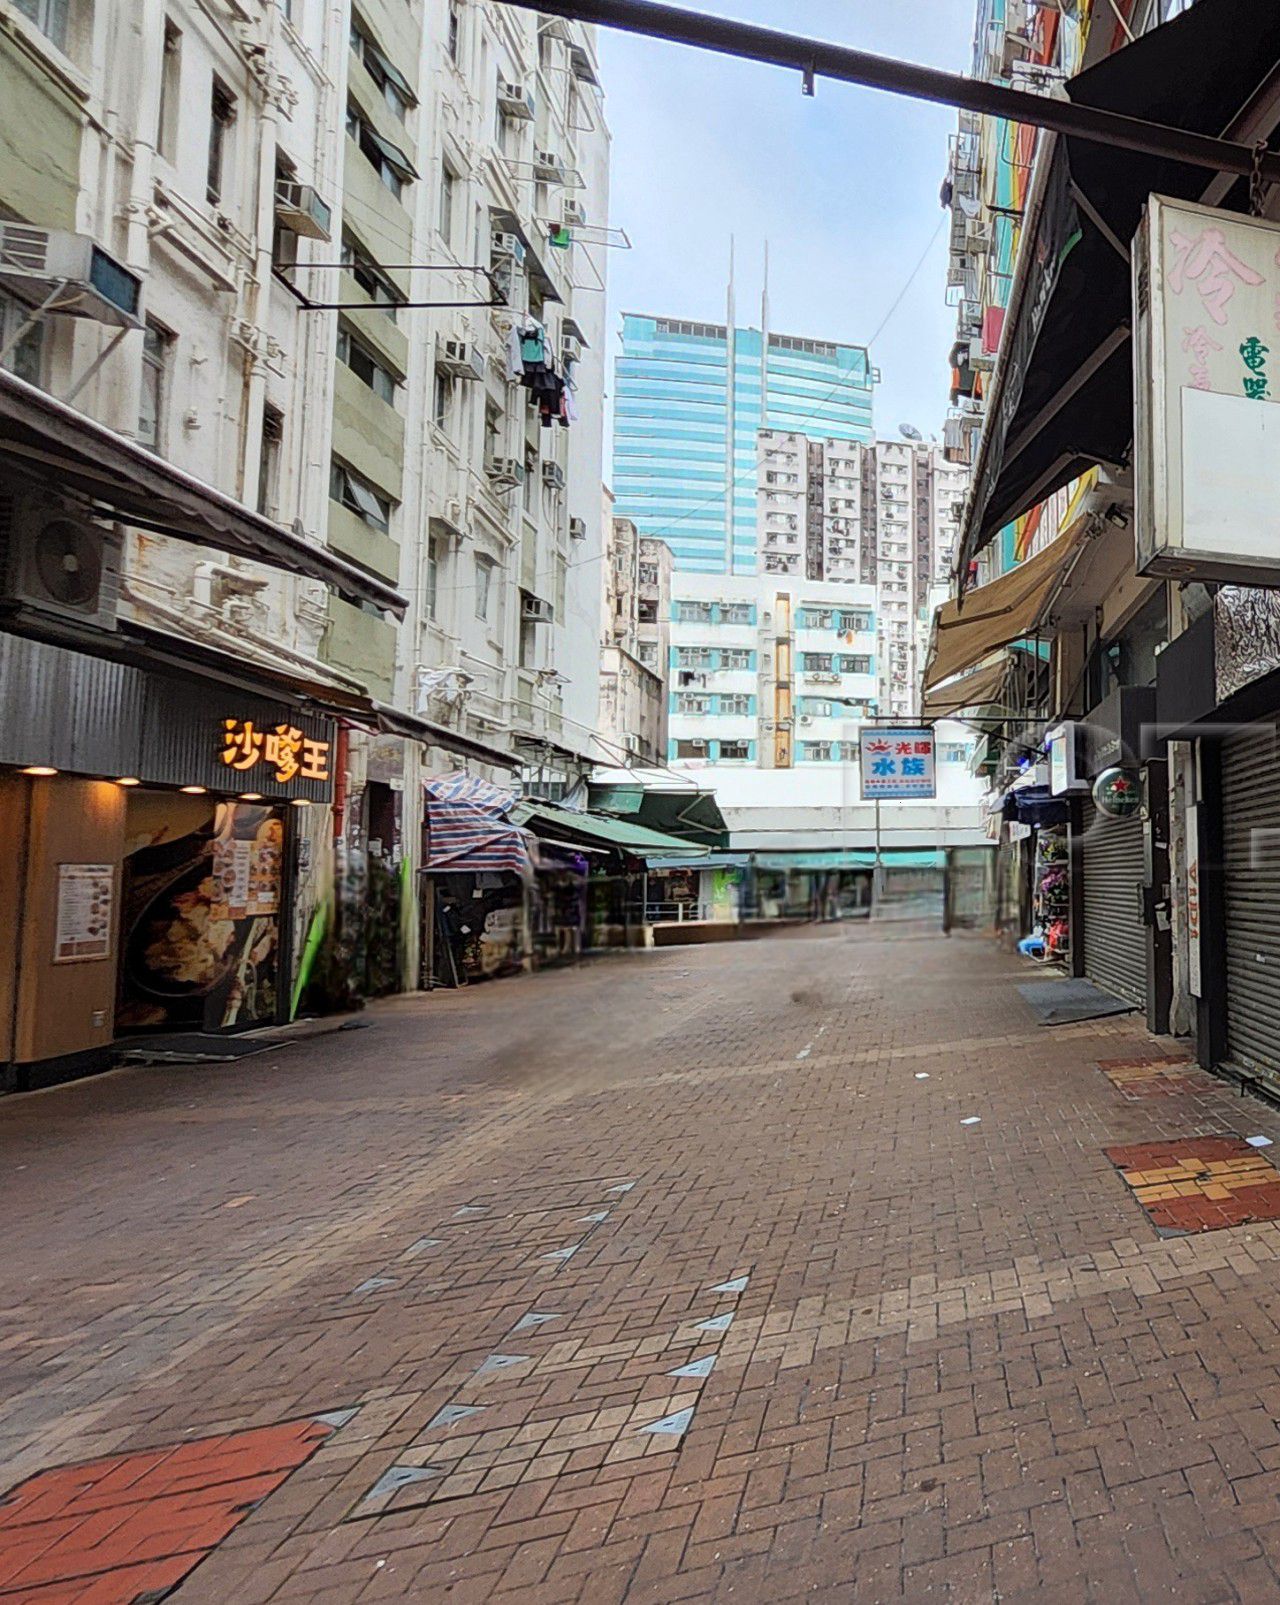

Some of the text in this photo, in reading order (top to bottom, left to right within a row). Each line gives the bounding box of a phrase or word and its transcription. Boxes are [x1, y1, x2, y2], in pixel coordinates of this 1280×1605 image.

[221, 718, 331, 783] 沙嗲王
[871, 756, 925, 776] 水族
